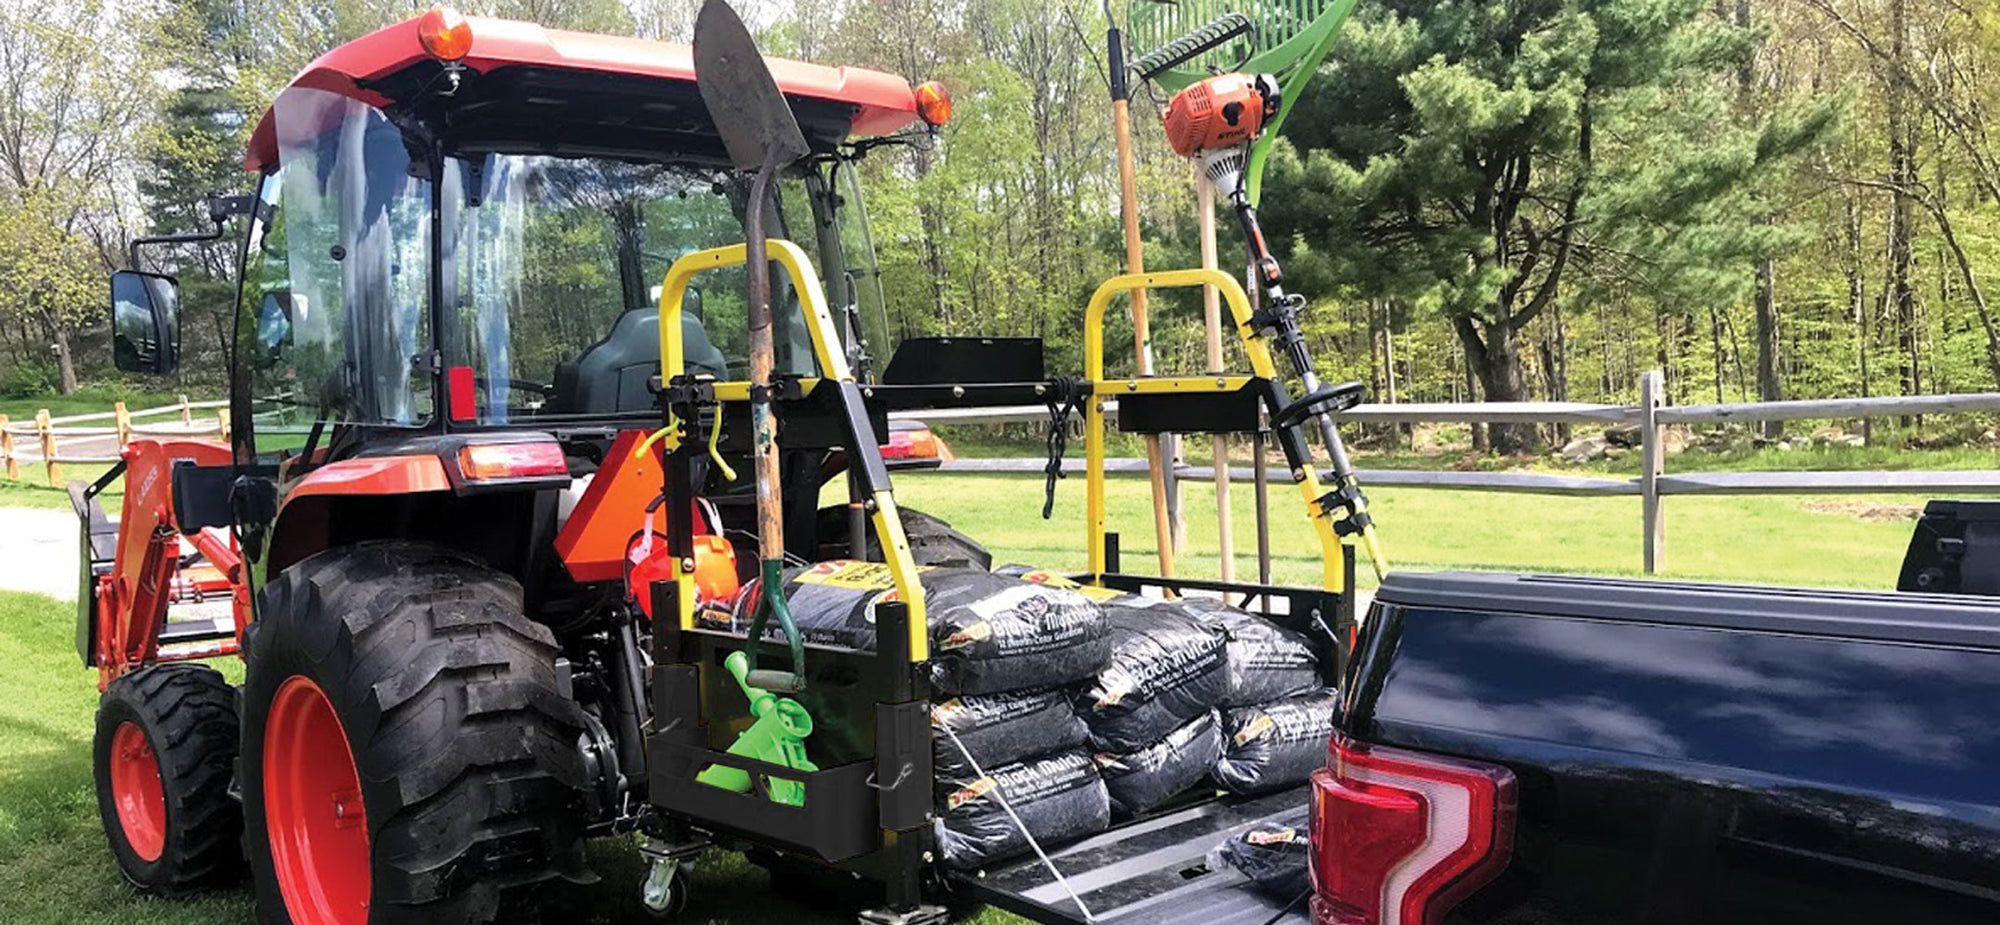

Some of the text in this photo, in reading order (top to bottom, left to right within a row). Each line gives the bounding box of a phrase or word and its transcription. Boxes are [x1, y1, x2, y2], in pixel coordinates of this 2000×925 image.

[1131, 656, 1170, 685] Black
[1171, 637, 1217, 664] Mulch
[995, 766, 1040, 788] Black
[1037, 753, 1086, 775] Mulch
[1013, 786, 1035, 797] Month
